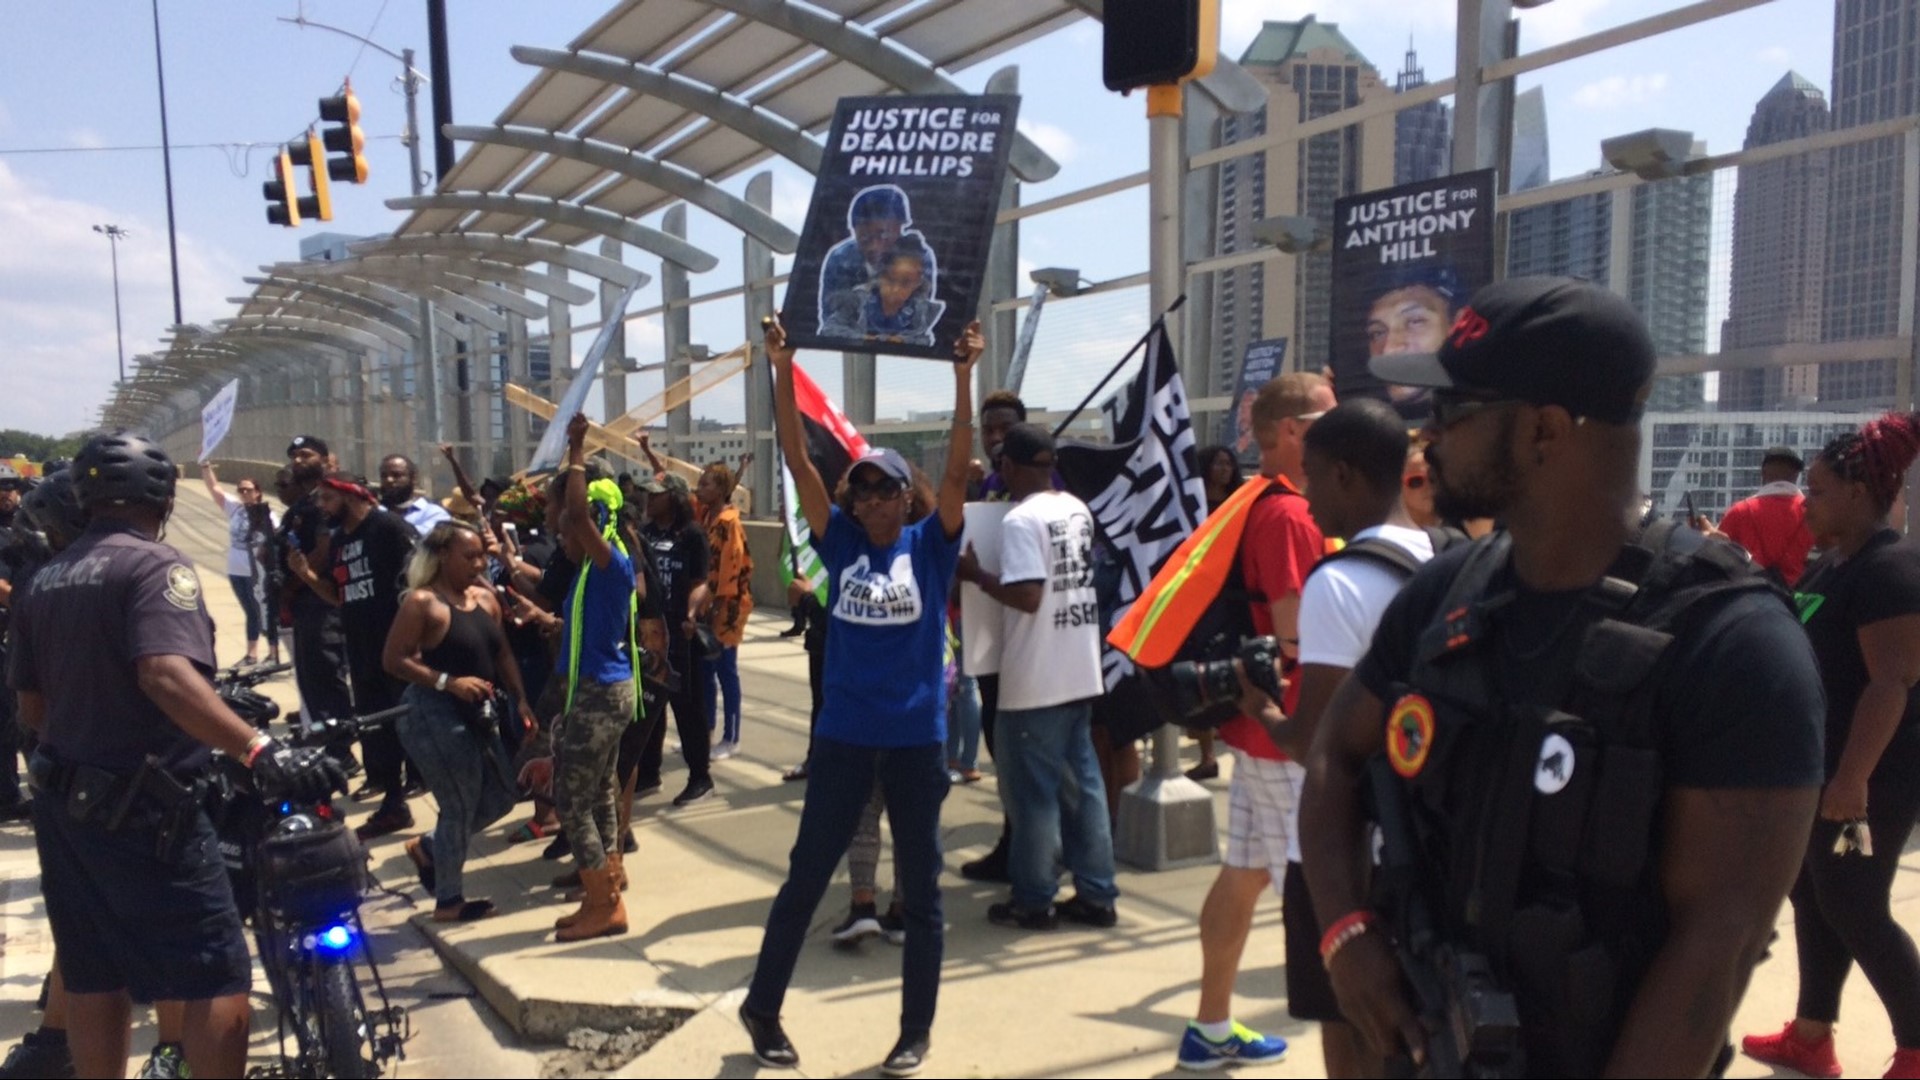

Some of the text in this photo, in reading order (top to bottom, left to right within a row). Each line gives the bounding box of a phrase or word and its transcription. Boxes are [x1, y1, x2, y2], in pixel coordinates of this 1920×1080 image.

[847, 107, 1001, 131] JUSTICE FOR
[840, 131, 996, 153] DEAUNDRE
[850, 156, 973, 177] PHILLIPS
[1346, 188, 1478, 226] JUSTICE FOR
[1345, 208, 1476, 249] ANTHONY
[1381, 238, 1437, 264] HILL
[30, 556, 110, 596] POLICE
[842, 579, 872, 602] FOR
[841, 597, 888, 618] LIVES
